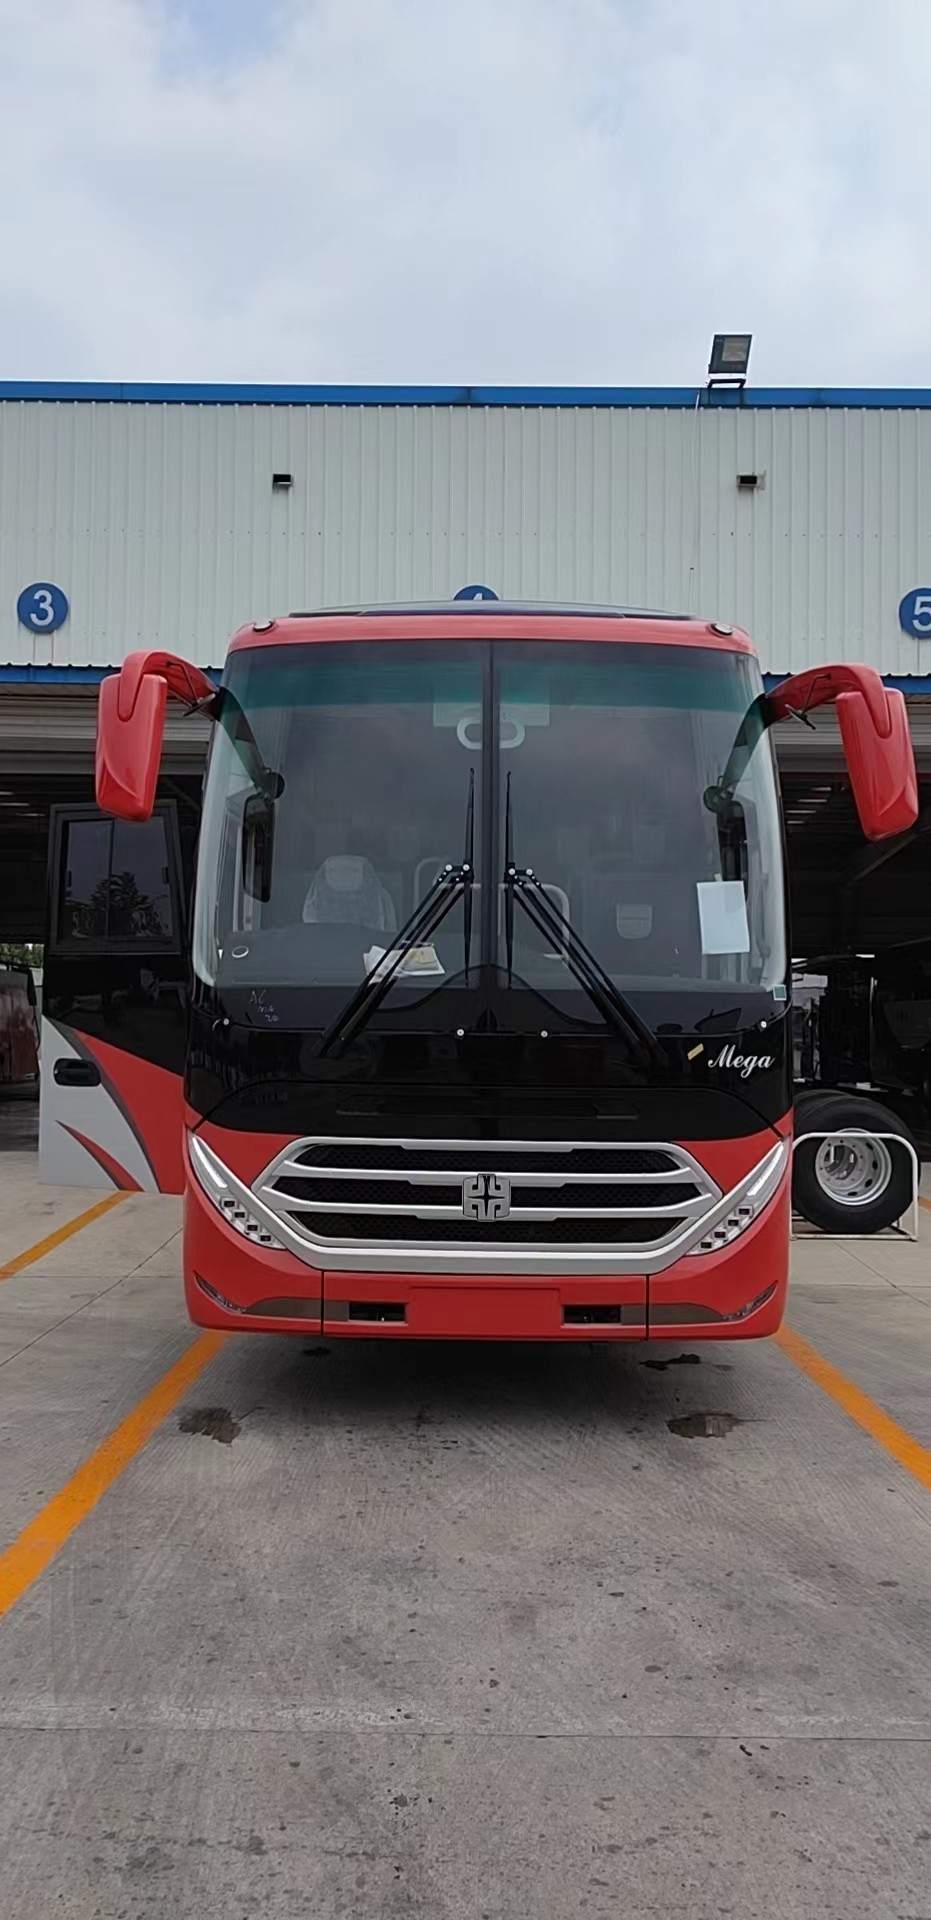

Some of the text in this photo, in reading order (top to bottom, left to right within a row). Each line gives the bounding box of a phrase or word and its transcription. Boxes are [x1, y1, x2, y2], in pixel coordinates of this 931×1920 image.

[30, 589, 54, 626] 3
[912, 595, 931, 632] 5
[707, 1044, 775, 1078] Mega
